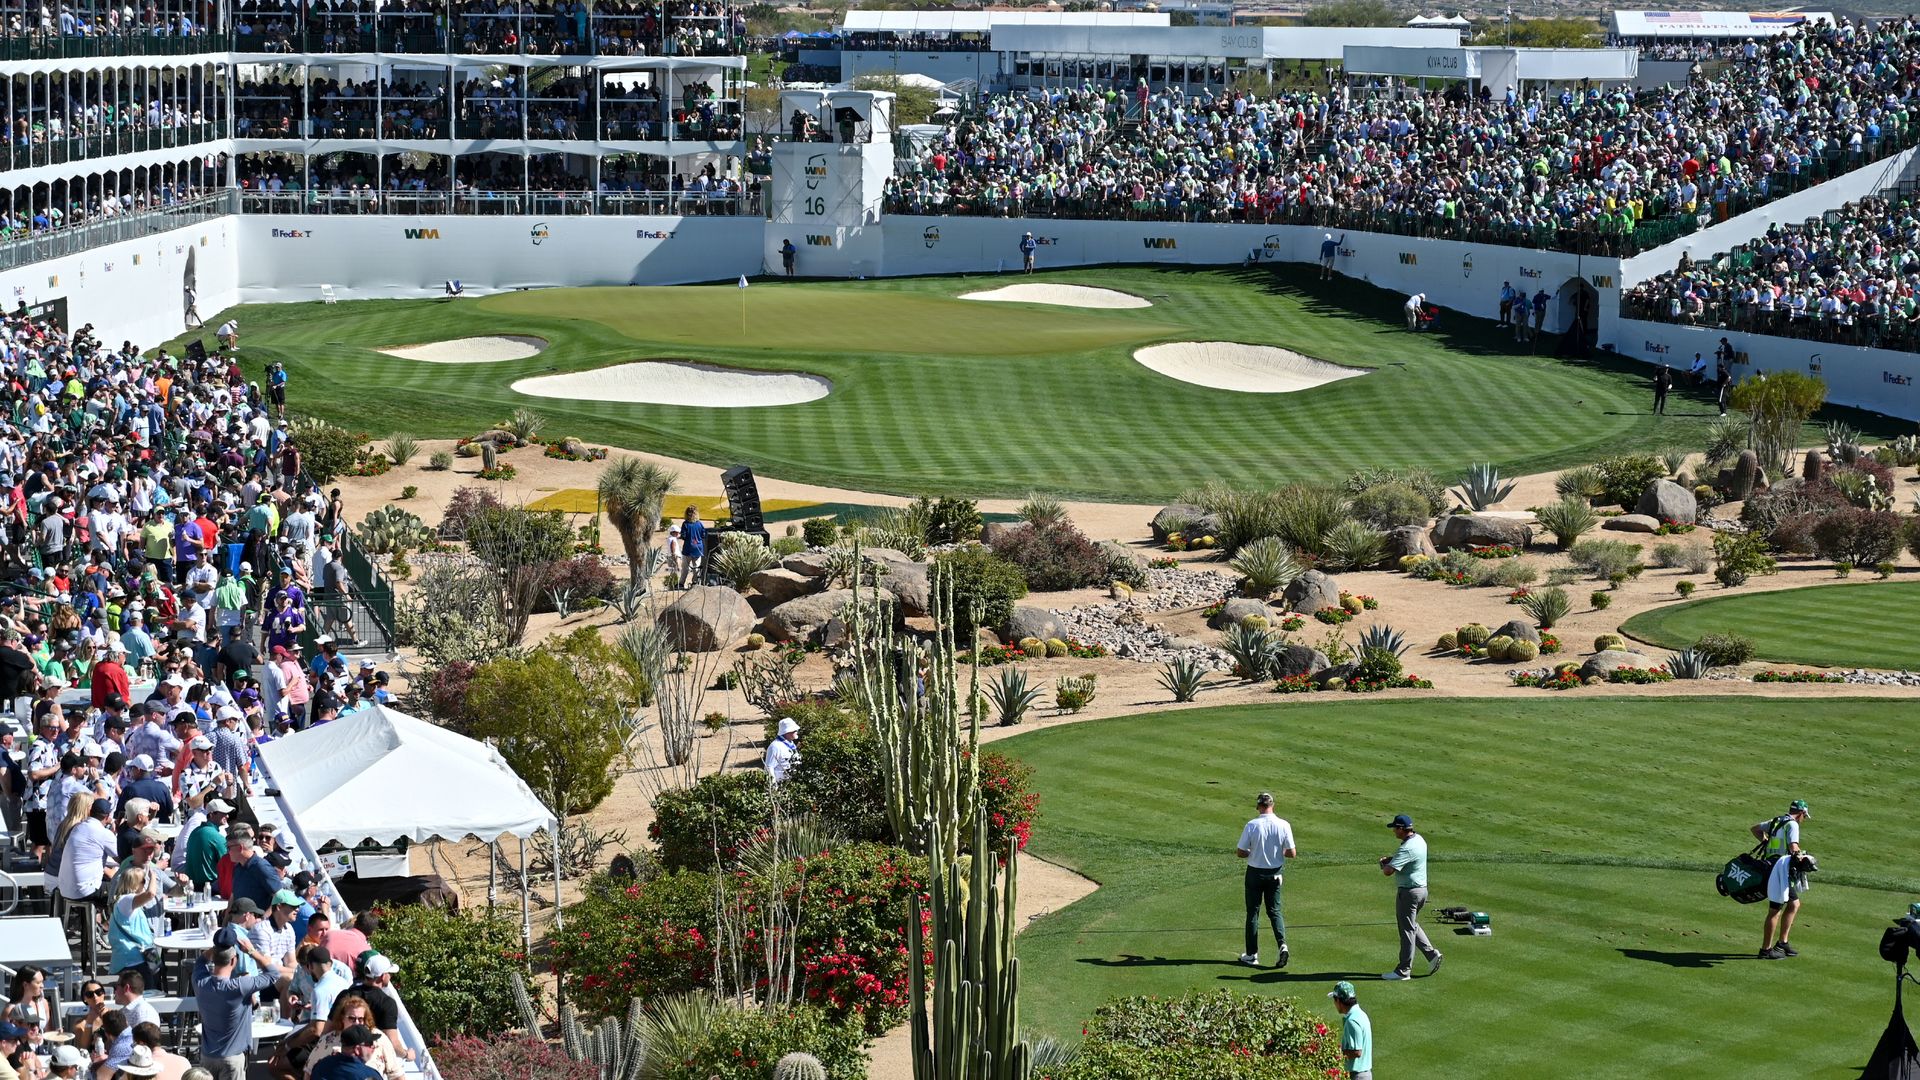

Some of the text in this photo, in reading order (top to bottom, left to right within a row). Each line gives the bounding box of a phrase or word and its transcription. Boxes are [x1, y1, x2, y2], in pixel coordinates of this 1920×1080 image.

[1222, 35, 1257, 48] BAY CLUB
[1428, 56, 1457, 69] KIVA CLUB
[805, 166, 827, 175] WM
[805, 196, 825, 216] 16
[279, 230, 303, 238] FedEx
[404, 229, 440, 239] WM
[644, 231, 667, 239] FedEx
[806, 235, 832, 246] WM
[1144, 238, 1176, 248] WM
[1399, 253, 1416, 265] WM
[1592, 275, 1613, 288] WM
